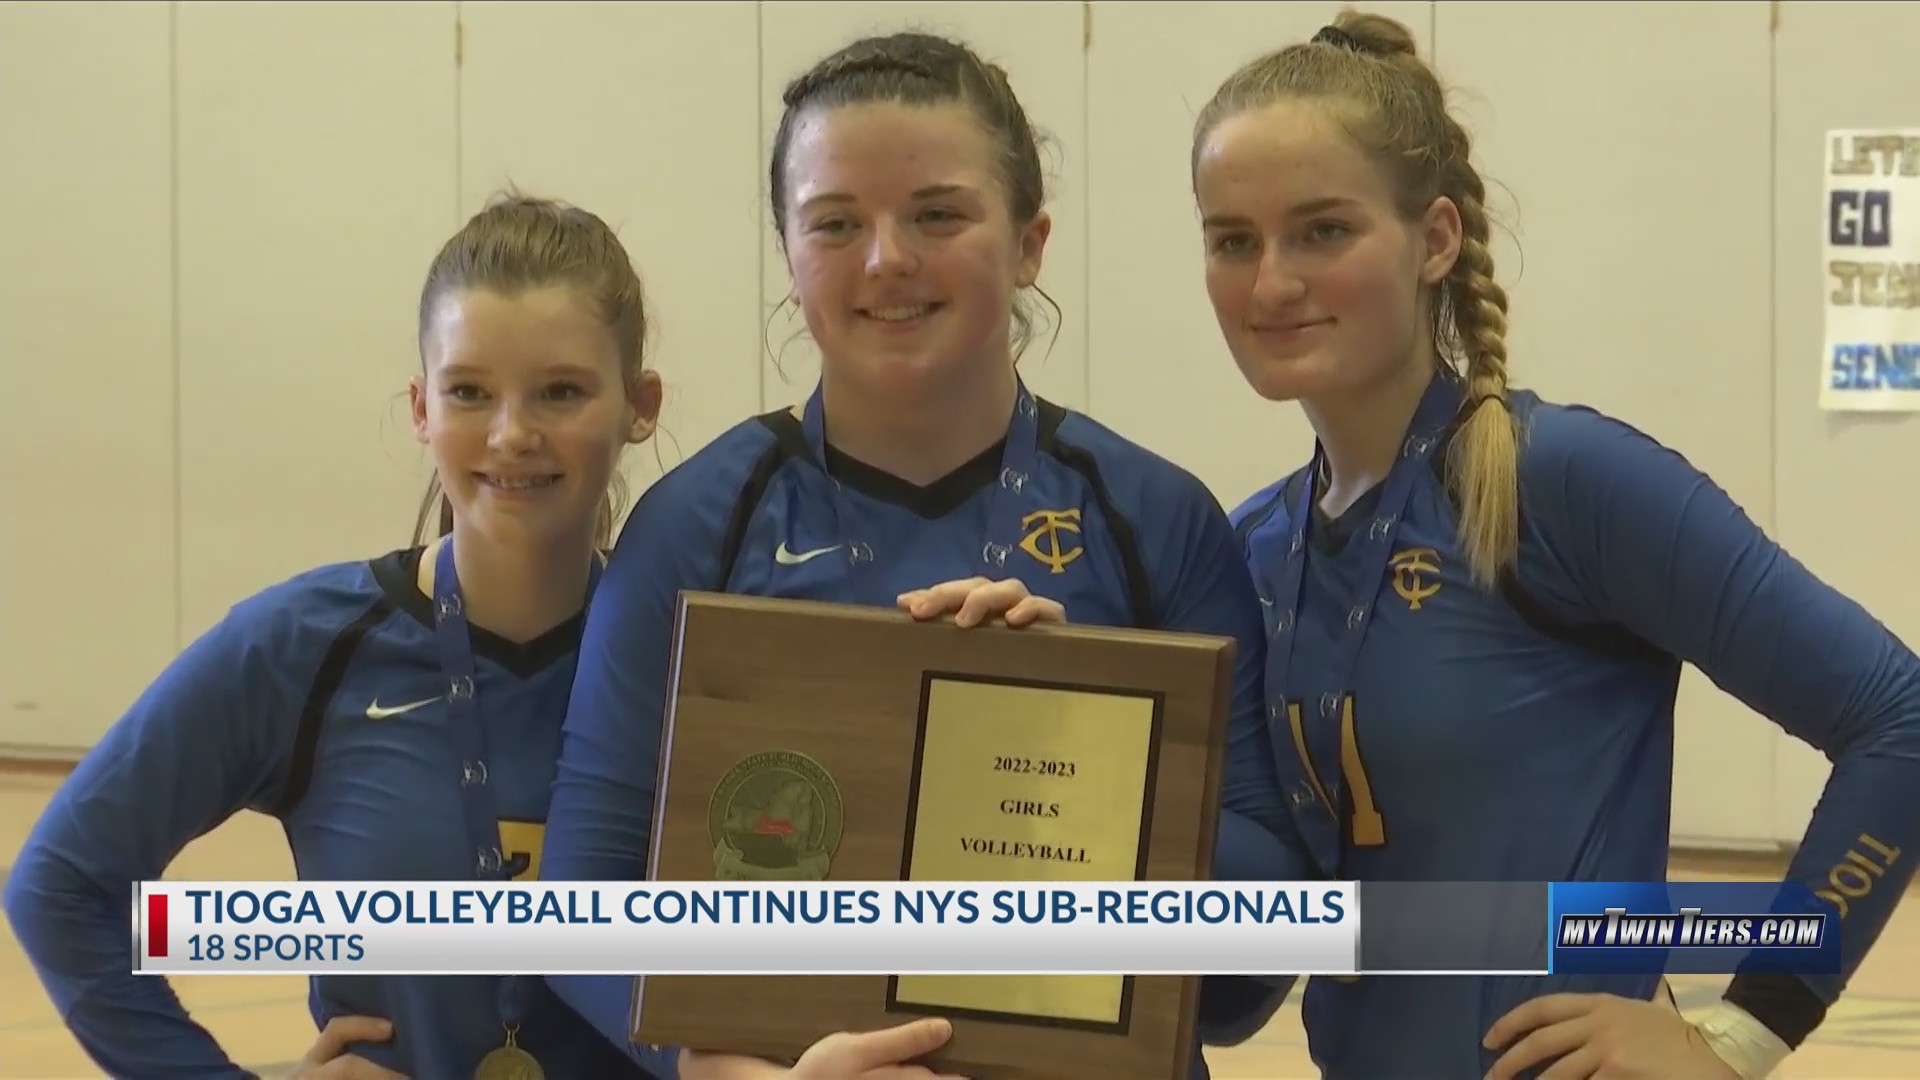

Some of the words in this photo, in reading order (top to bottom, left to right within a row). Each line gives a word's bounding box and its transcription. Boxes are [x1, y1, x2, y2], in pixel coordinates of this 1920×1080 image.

[1830, 190, 1890, 246] GO
[993, 755, 1076, 777] 2022-2023
[1000, 799, 1060, 817] GIRLS
[960, 837, 1091, 864] VOLLEYBALL
